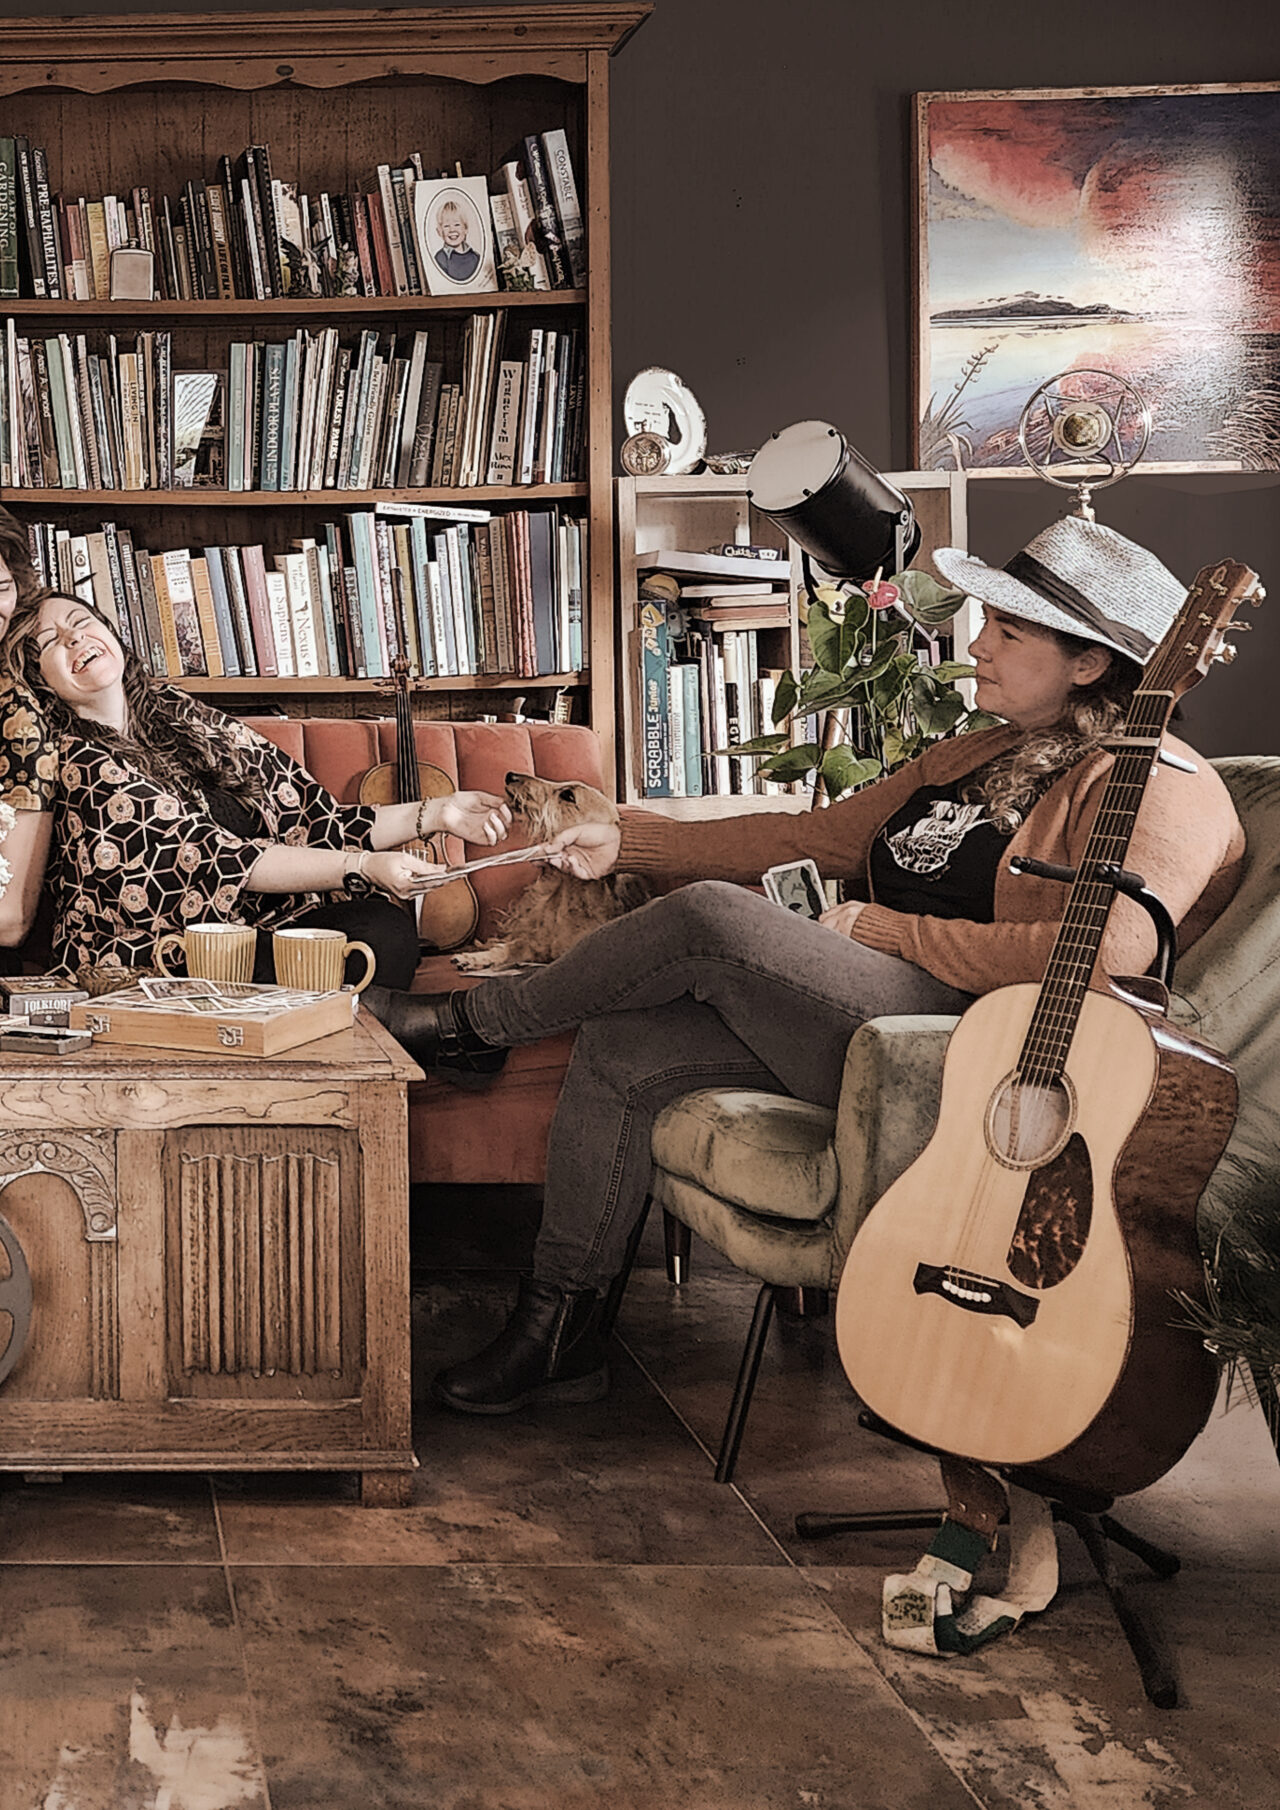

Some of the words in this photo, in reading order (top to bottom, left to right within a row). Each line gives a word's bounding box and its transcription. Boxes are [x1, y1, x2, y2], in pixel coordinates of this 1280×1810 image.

[20, 150, 28, 165] NEW
[7, 175, 15, 194] THE
[21, 165, 30, 192] ZEALAND
[556, 148, 574, 202] CONSTABLE
[8, 199, 16, 219] ART
[209, 189, 221, 212] GEOFF
[9, 221, 16, 237] OF
[37, 183, 59, 285] PRE-RAPHAELITES
[211, 212, 226, 243] MURPHY
[218, 249, 227, 262] LIFE
[221, 274, 230, 291] FILM
[372, 370, 380, 382] Bee
[129, 382, 138, 410] LIVING
[333, 388, 345, 426] FOREST
[368, 383, 378, 409] Friendly
[132, 413, 139, 423] IN
[365, 411, 375, 436] Garden
[330, 427, 341, 460] PARKS
[724, 546, 758, 558] Quiddler
[274, 596, 288, 643] Sapiens
[296, 617, 310, 658] Nexus
[647, 678, 659, 712] Junior
[672, 711, 682, 760] Romantics
[728, 717, 739, 760] EGYT
[646, 713, 663, 788] SCRABBLE
